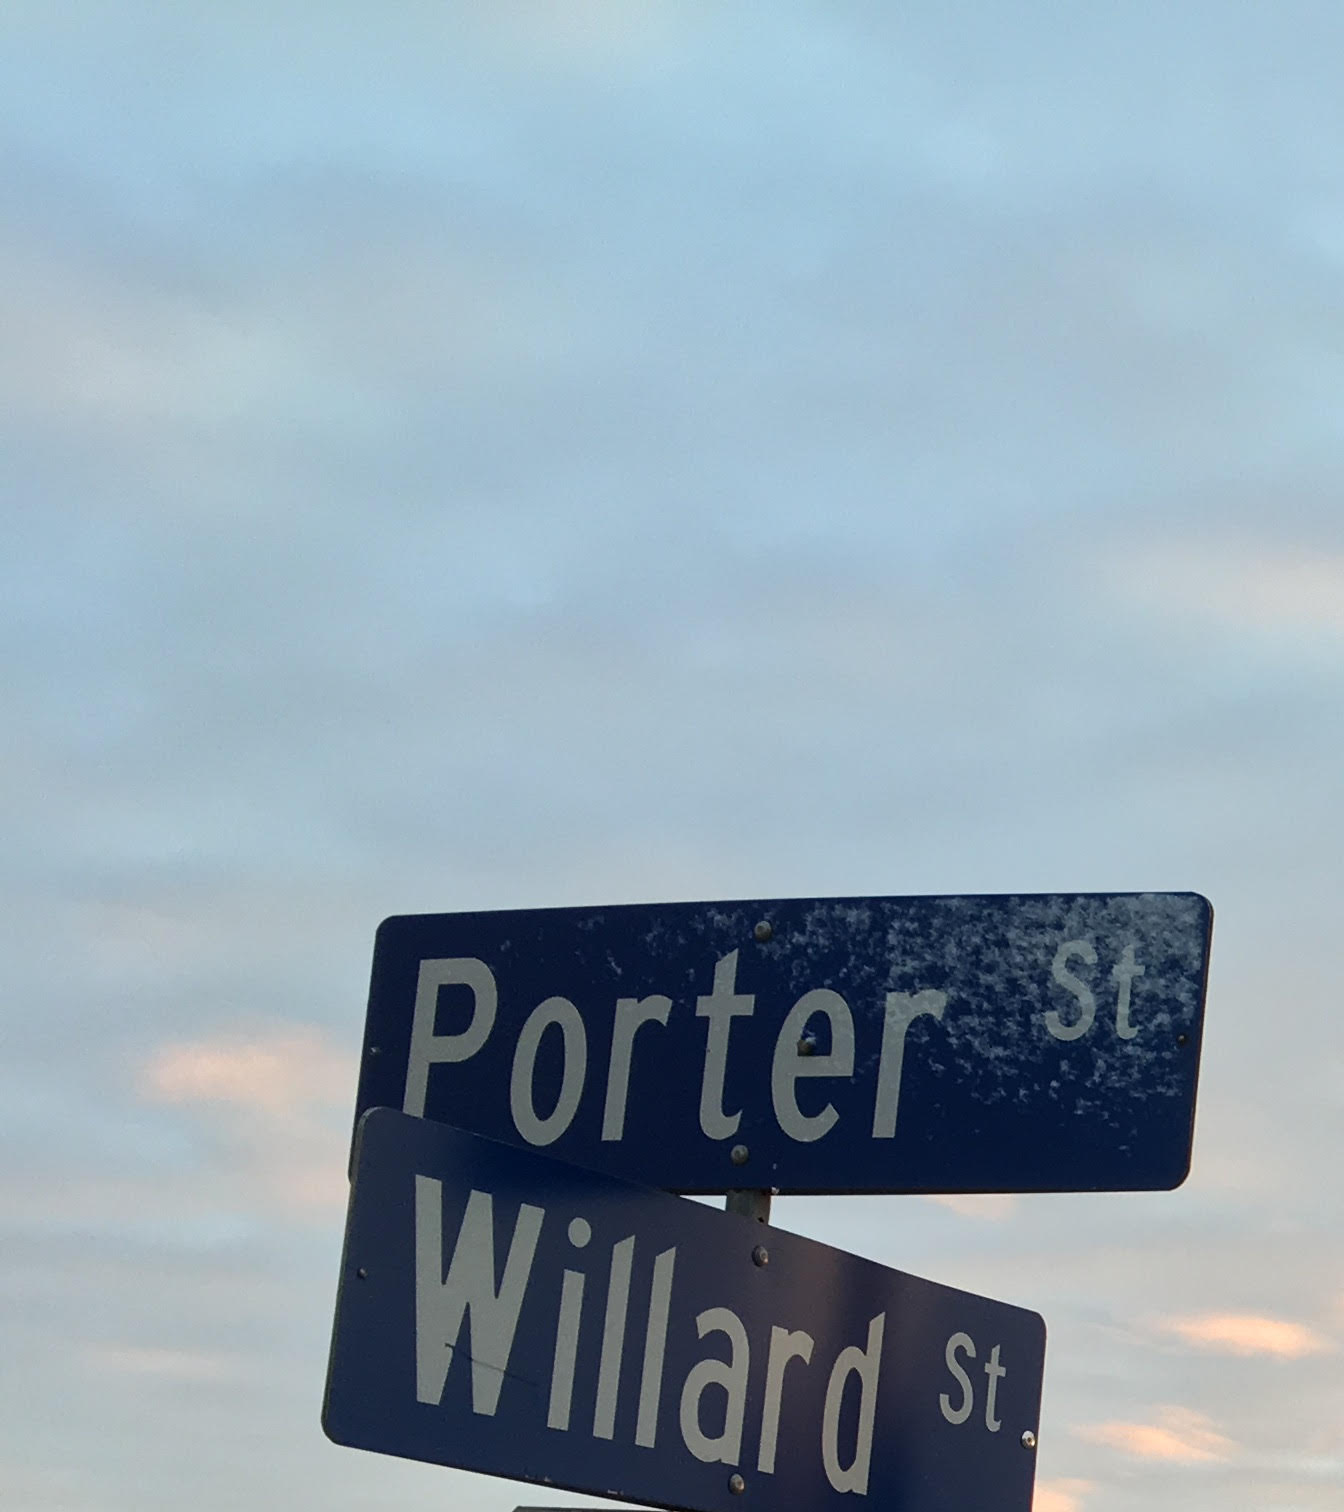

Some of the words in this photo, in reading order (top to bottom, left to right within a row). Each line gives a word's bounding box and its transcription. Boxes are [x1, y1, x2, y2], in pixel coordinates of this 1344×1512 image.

[402, 948, 947, 1147] Porter
[1045, 940, 1146, 1042] St
[414, 1174, 885, 1496] Willard
[939, 1332, 1007, 1433] St
